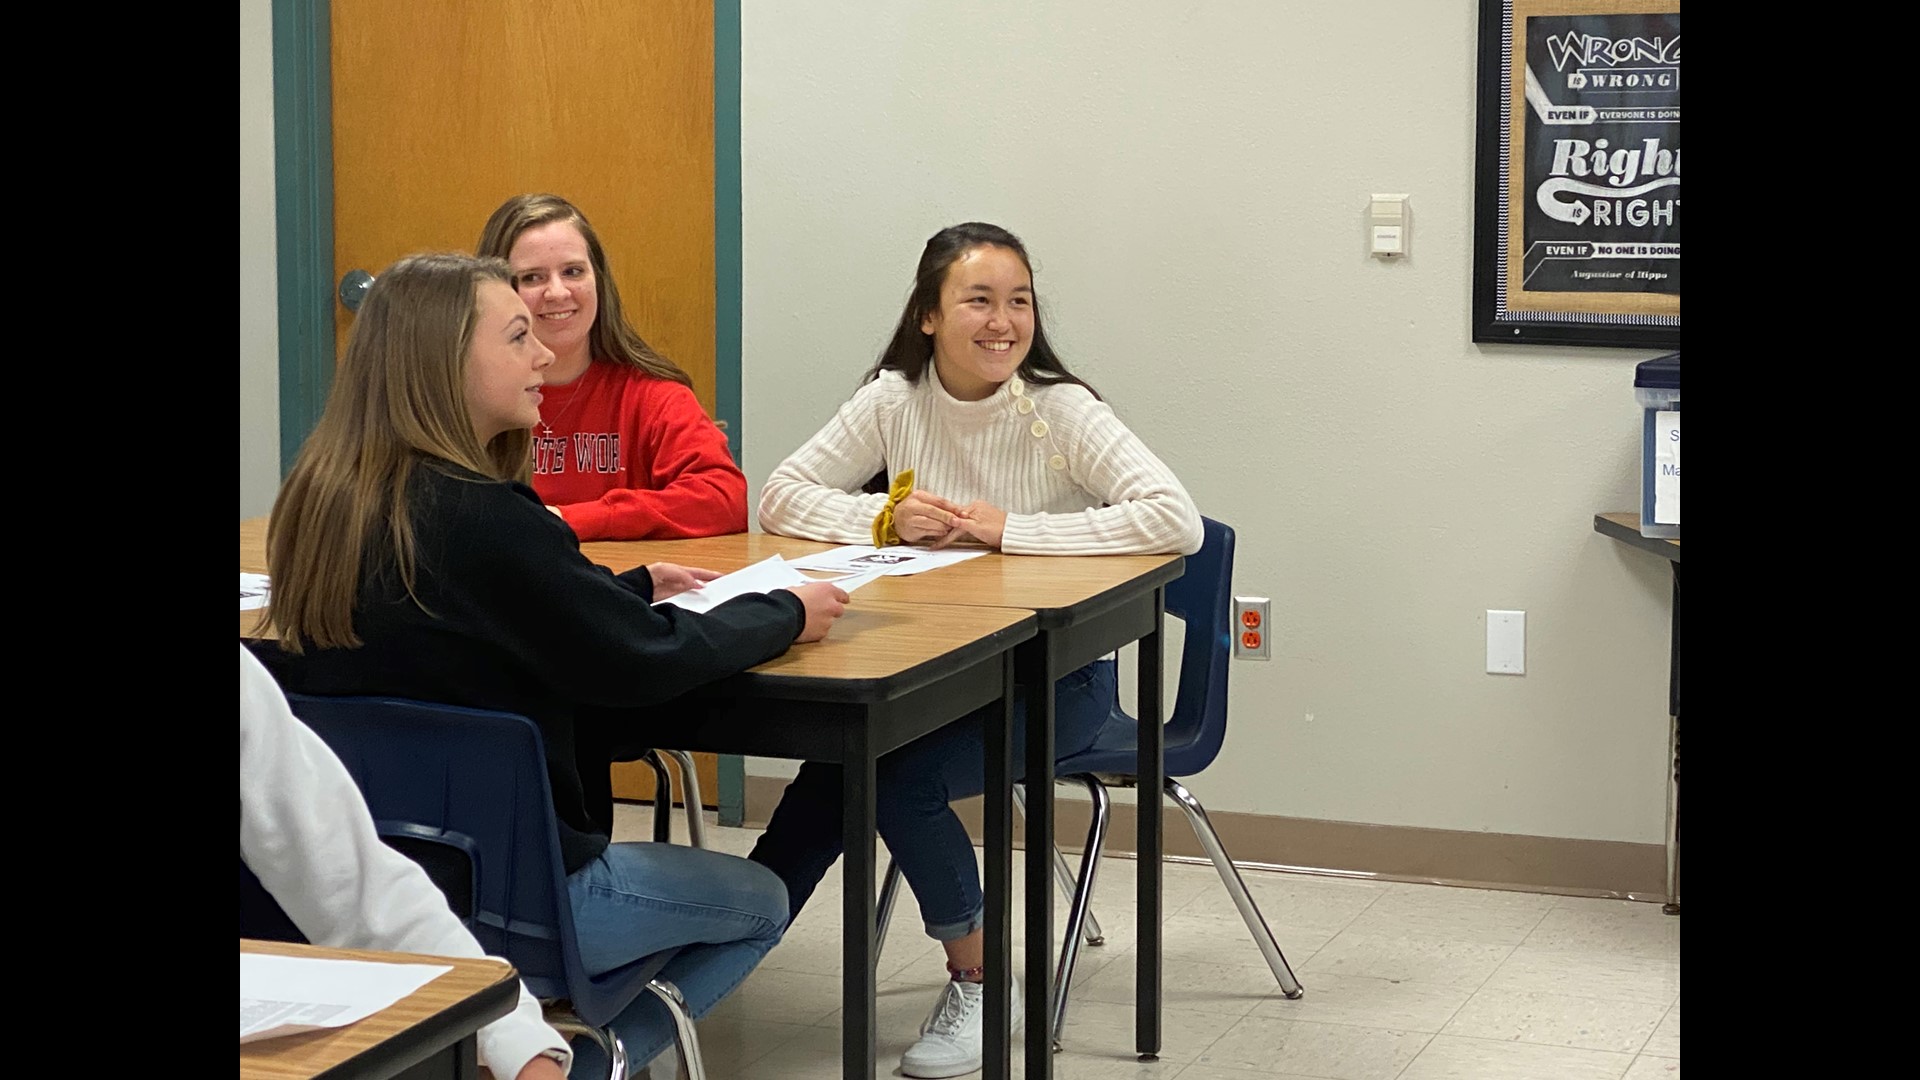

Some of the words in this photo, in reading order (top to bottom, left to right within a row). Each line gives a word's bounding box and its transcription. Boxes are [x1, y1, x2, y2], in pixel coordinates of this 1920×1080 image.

[1573, 76, 1582, 85] IS
[1591, 74, 1671, 87] WRONG
[1547, 111, 1577, 120] EVEN
[1580, 111, 1590, 120] IF
[1600, 111, 1645, 119] EVERYONE
[1646, 111, 1656, 119] IS
[1572, 208, 1582, 218] IS
[1593, 199, 1680, 227] RIGH
[1546, 246, 1574, 255] EVEN
[1577, 246, 1588, 255] IF
[1598, 247, 1612, 255] NO
[1615, 247, 1635, 255] ONE
[1637, 247, 1647, 255] IS
[1625, 270, 1635, 279] of
